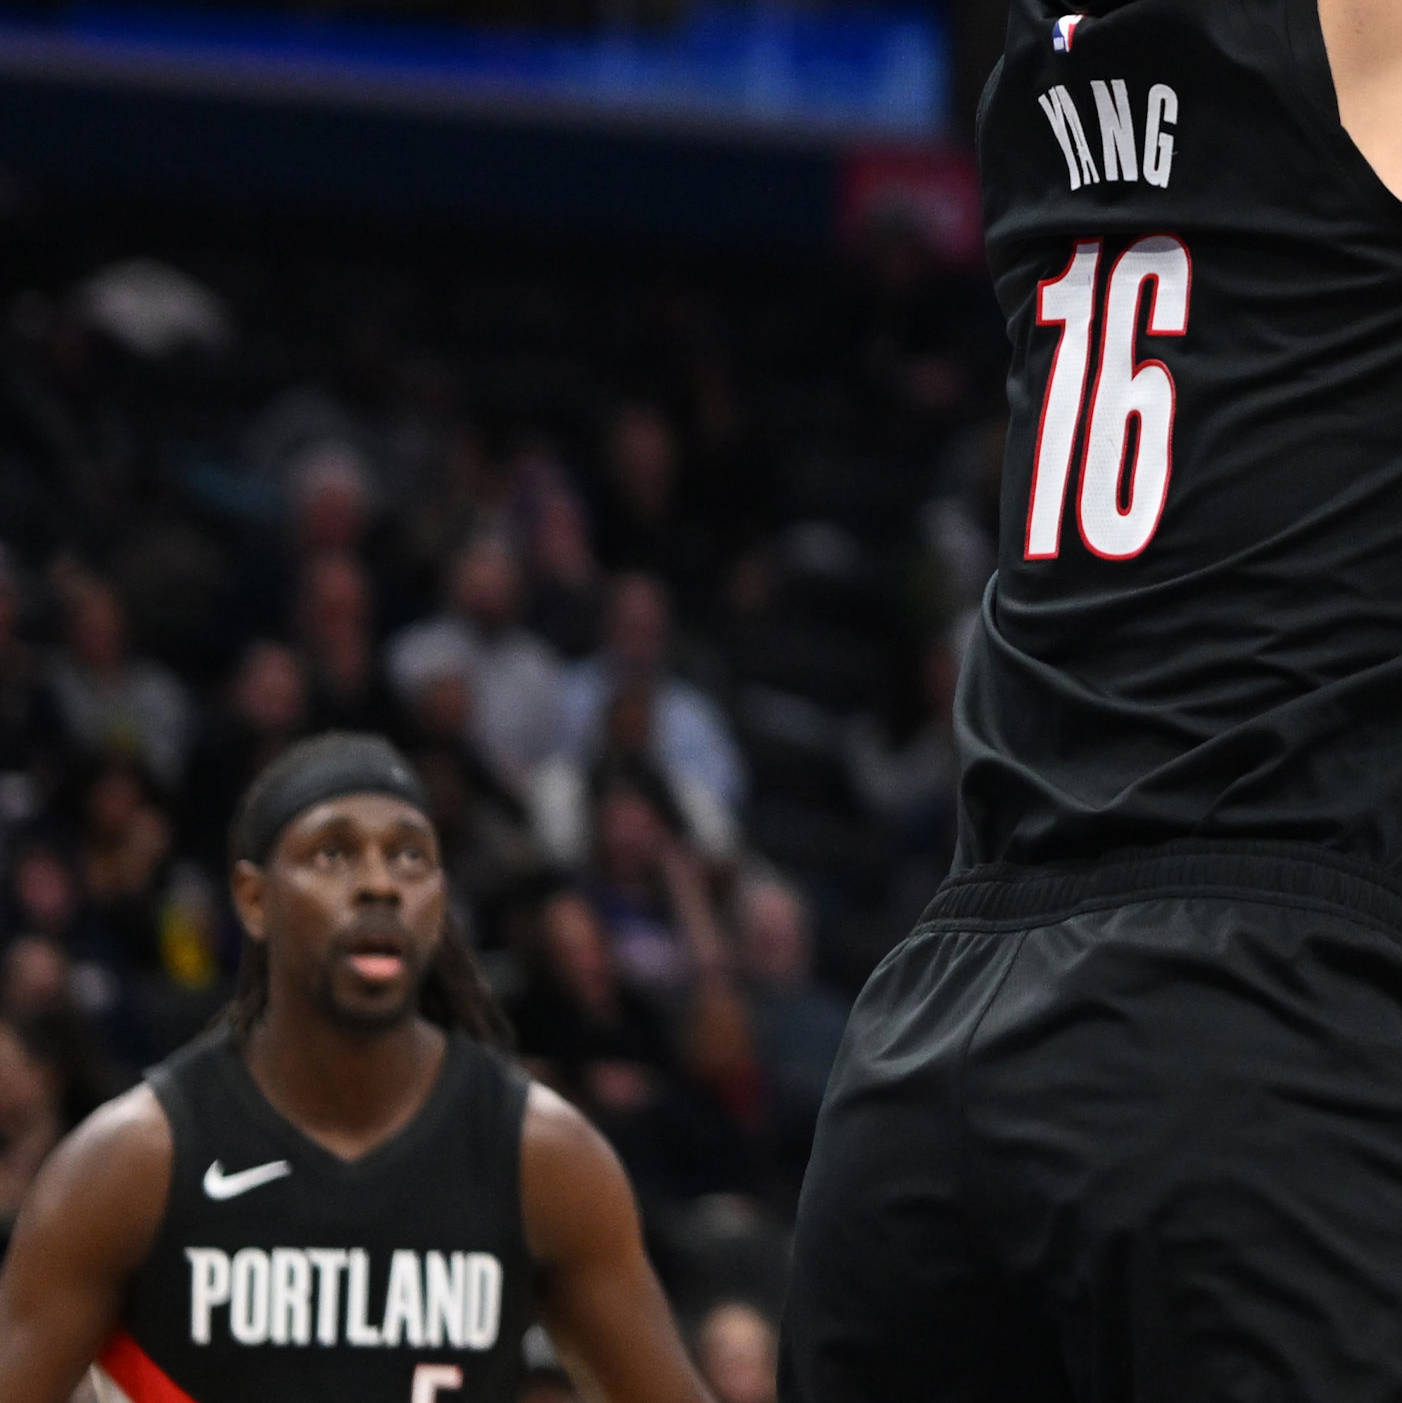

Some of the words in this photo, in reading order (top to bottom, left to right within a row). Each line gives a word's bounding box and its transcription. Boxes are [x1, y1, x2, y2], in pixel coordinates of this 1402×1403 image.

[1038, 79, 1178, 190] YANG
[1023, 233, 1192, 561] 16
[184, 1246, 502, 1350] PORTLAND
